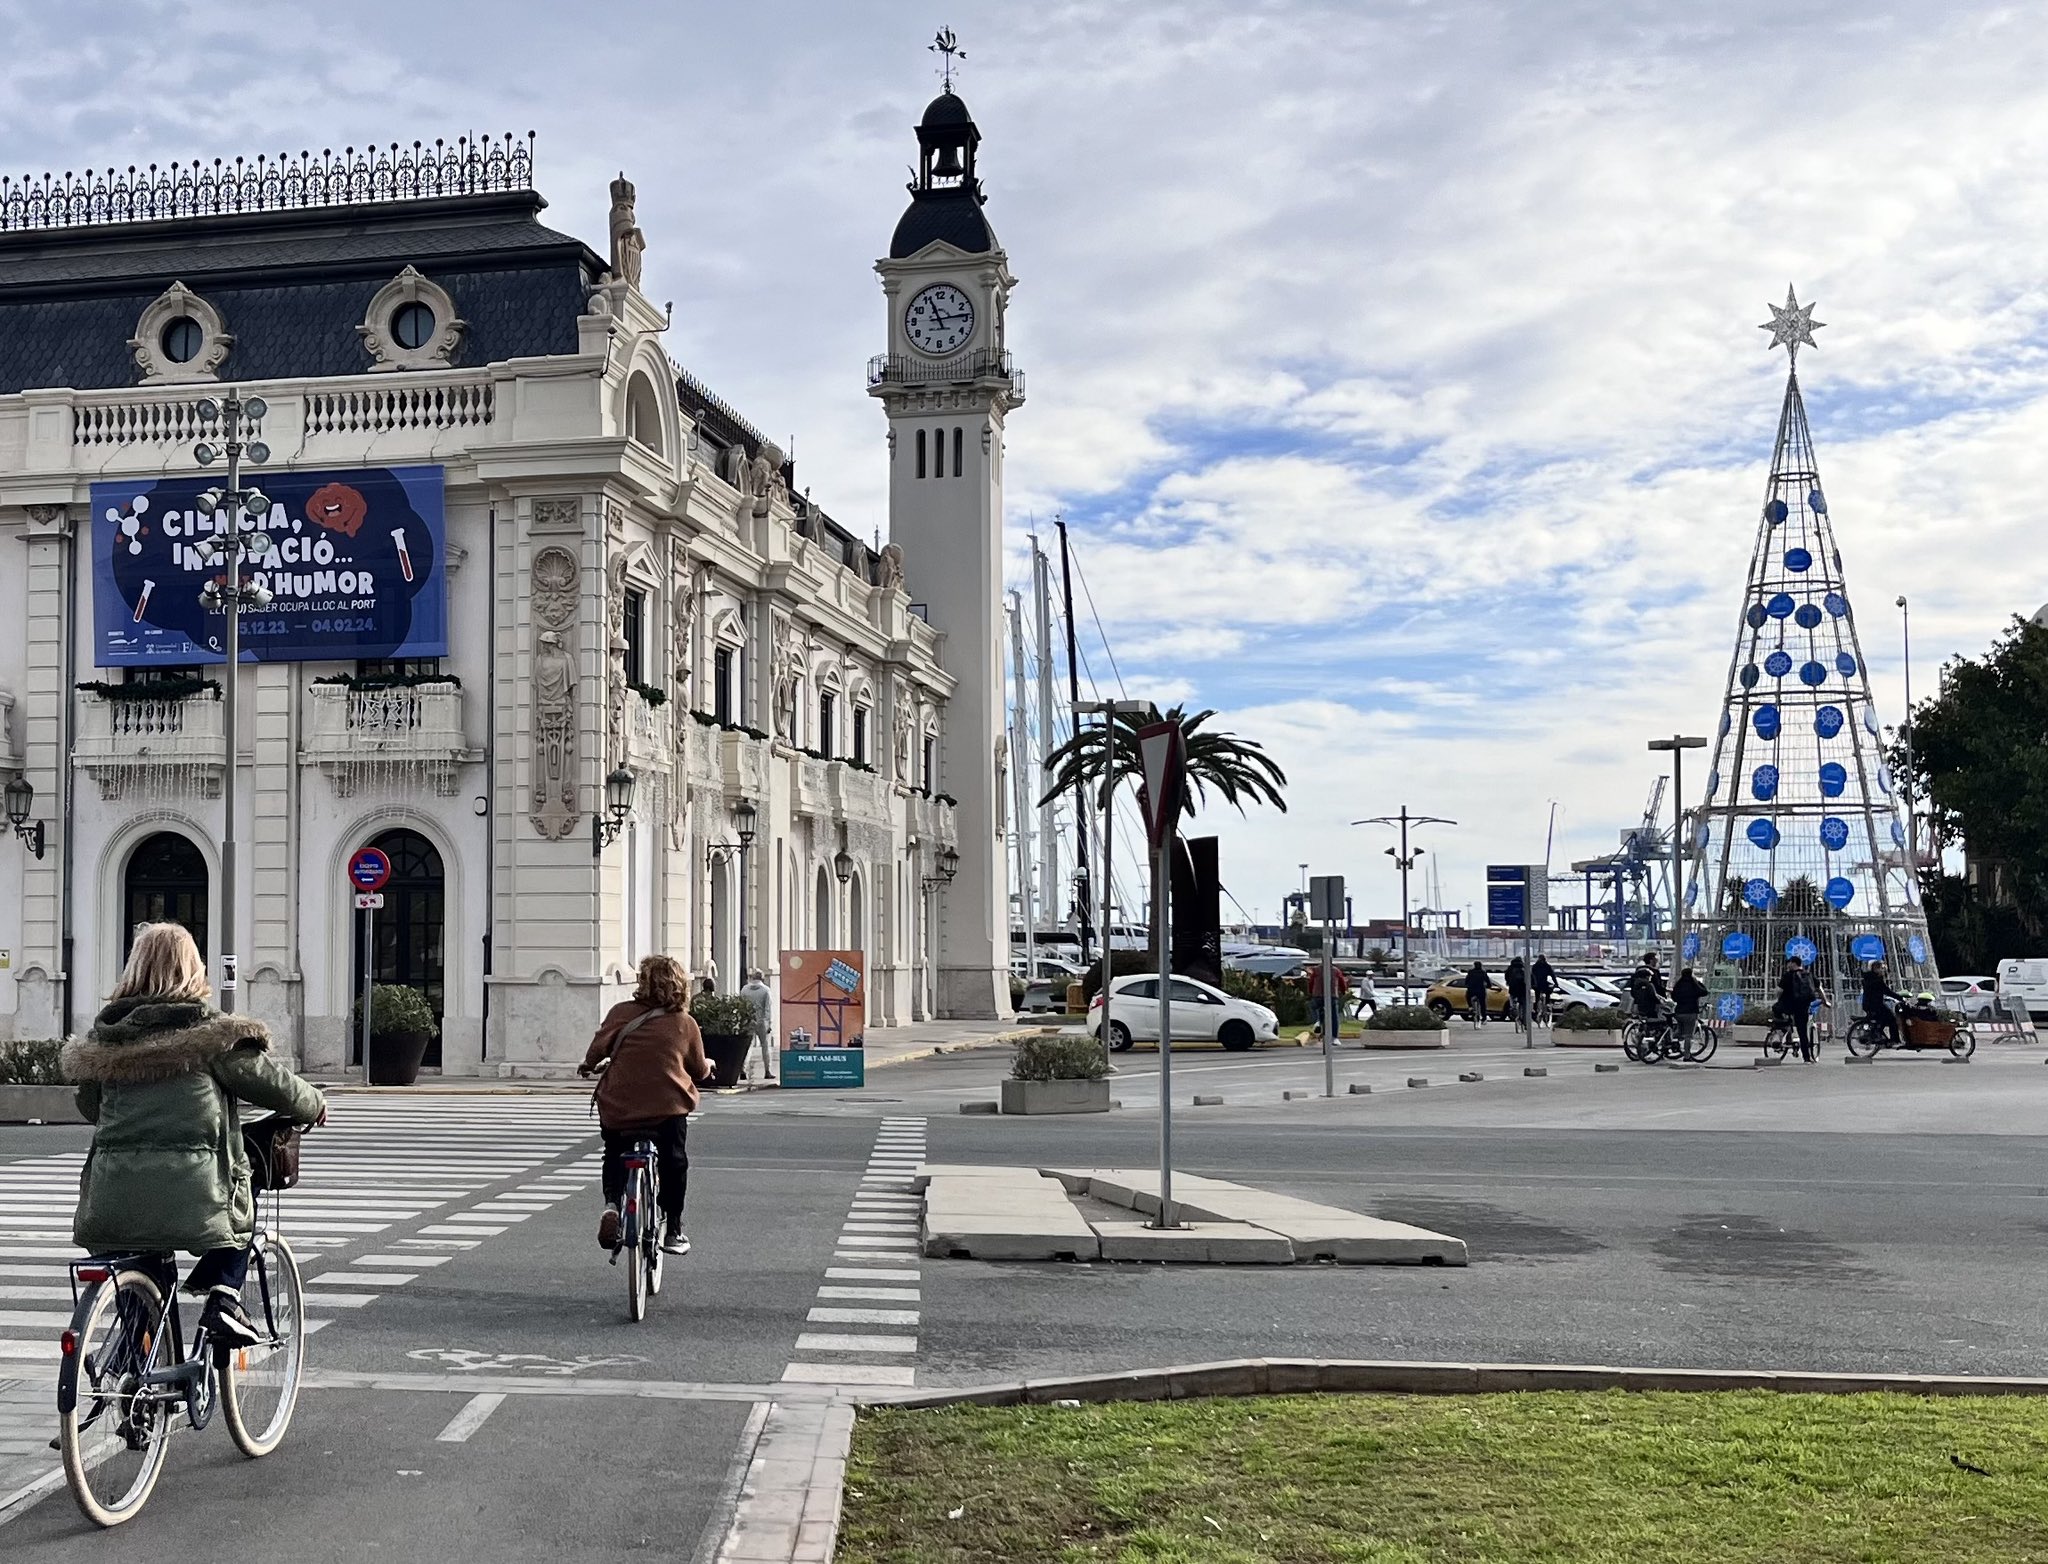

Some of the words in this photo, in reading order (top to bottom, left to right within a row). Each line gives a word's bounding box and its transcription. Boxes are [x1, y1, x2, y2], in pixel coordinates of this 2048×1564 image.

[935, 291, 945, 300] 12
[950, 294, 954, 303] 1
[923, 296, 932, 305] 11
[914, 306, 924, 314] 10
[958, 302, 964, 311] 2
[911, 317, 917, 326] 9
[915, 329, 921, 338] 8
[958, 327, 964, 335] 4
[925, 337, 931, 346] 7
[936, 340, 942, 349] 6
[949, 336, 955, 344] 5
[254, 570, 374, 597] D'HUMOR
[279, 601, 309, 612] OCUPA
[311, 600, 335, 611] LLOC
[336, 600, 349, 610] AL
[350, 599, 376, 610] PORT
[239, 620, 289, 635] 5.12.23.
[311, 618, 377, 633] 04.02.24.
